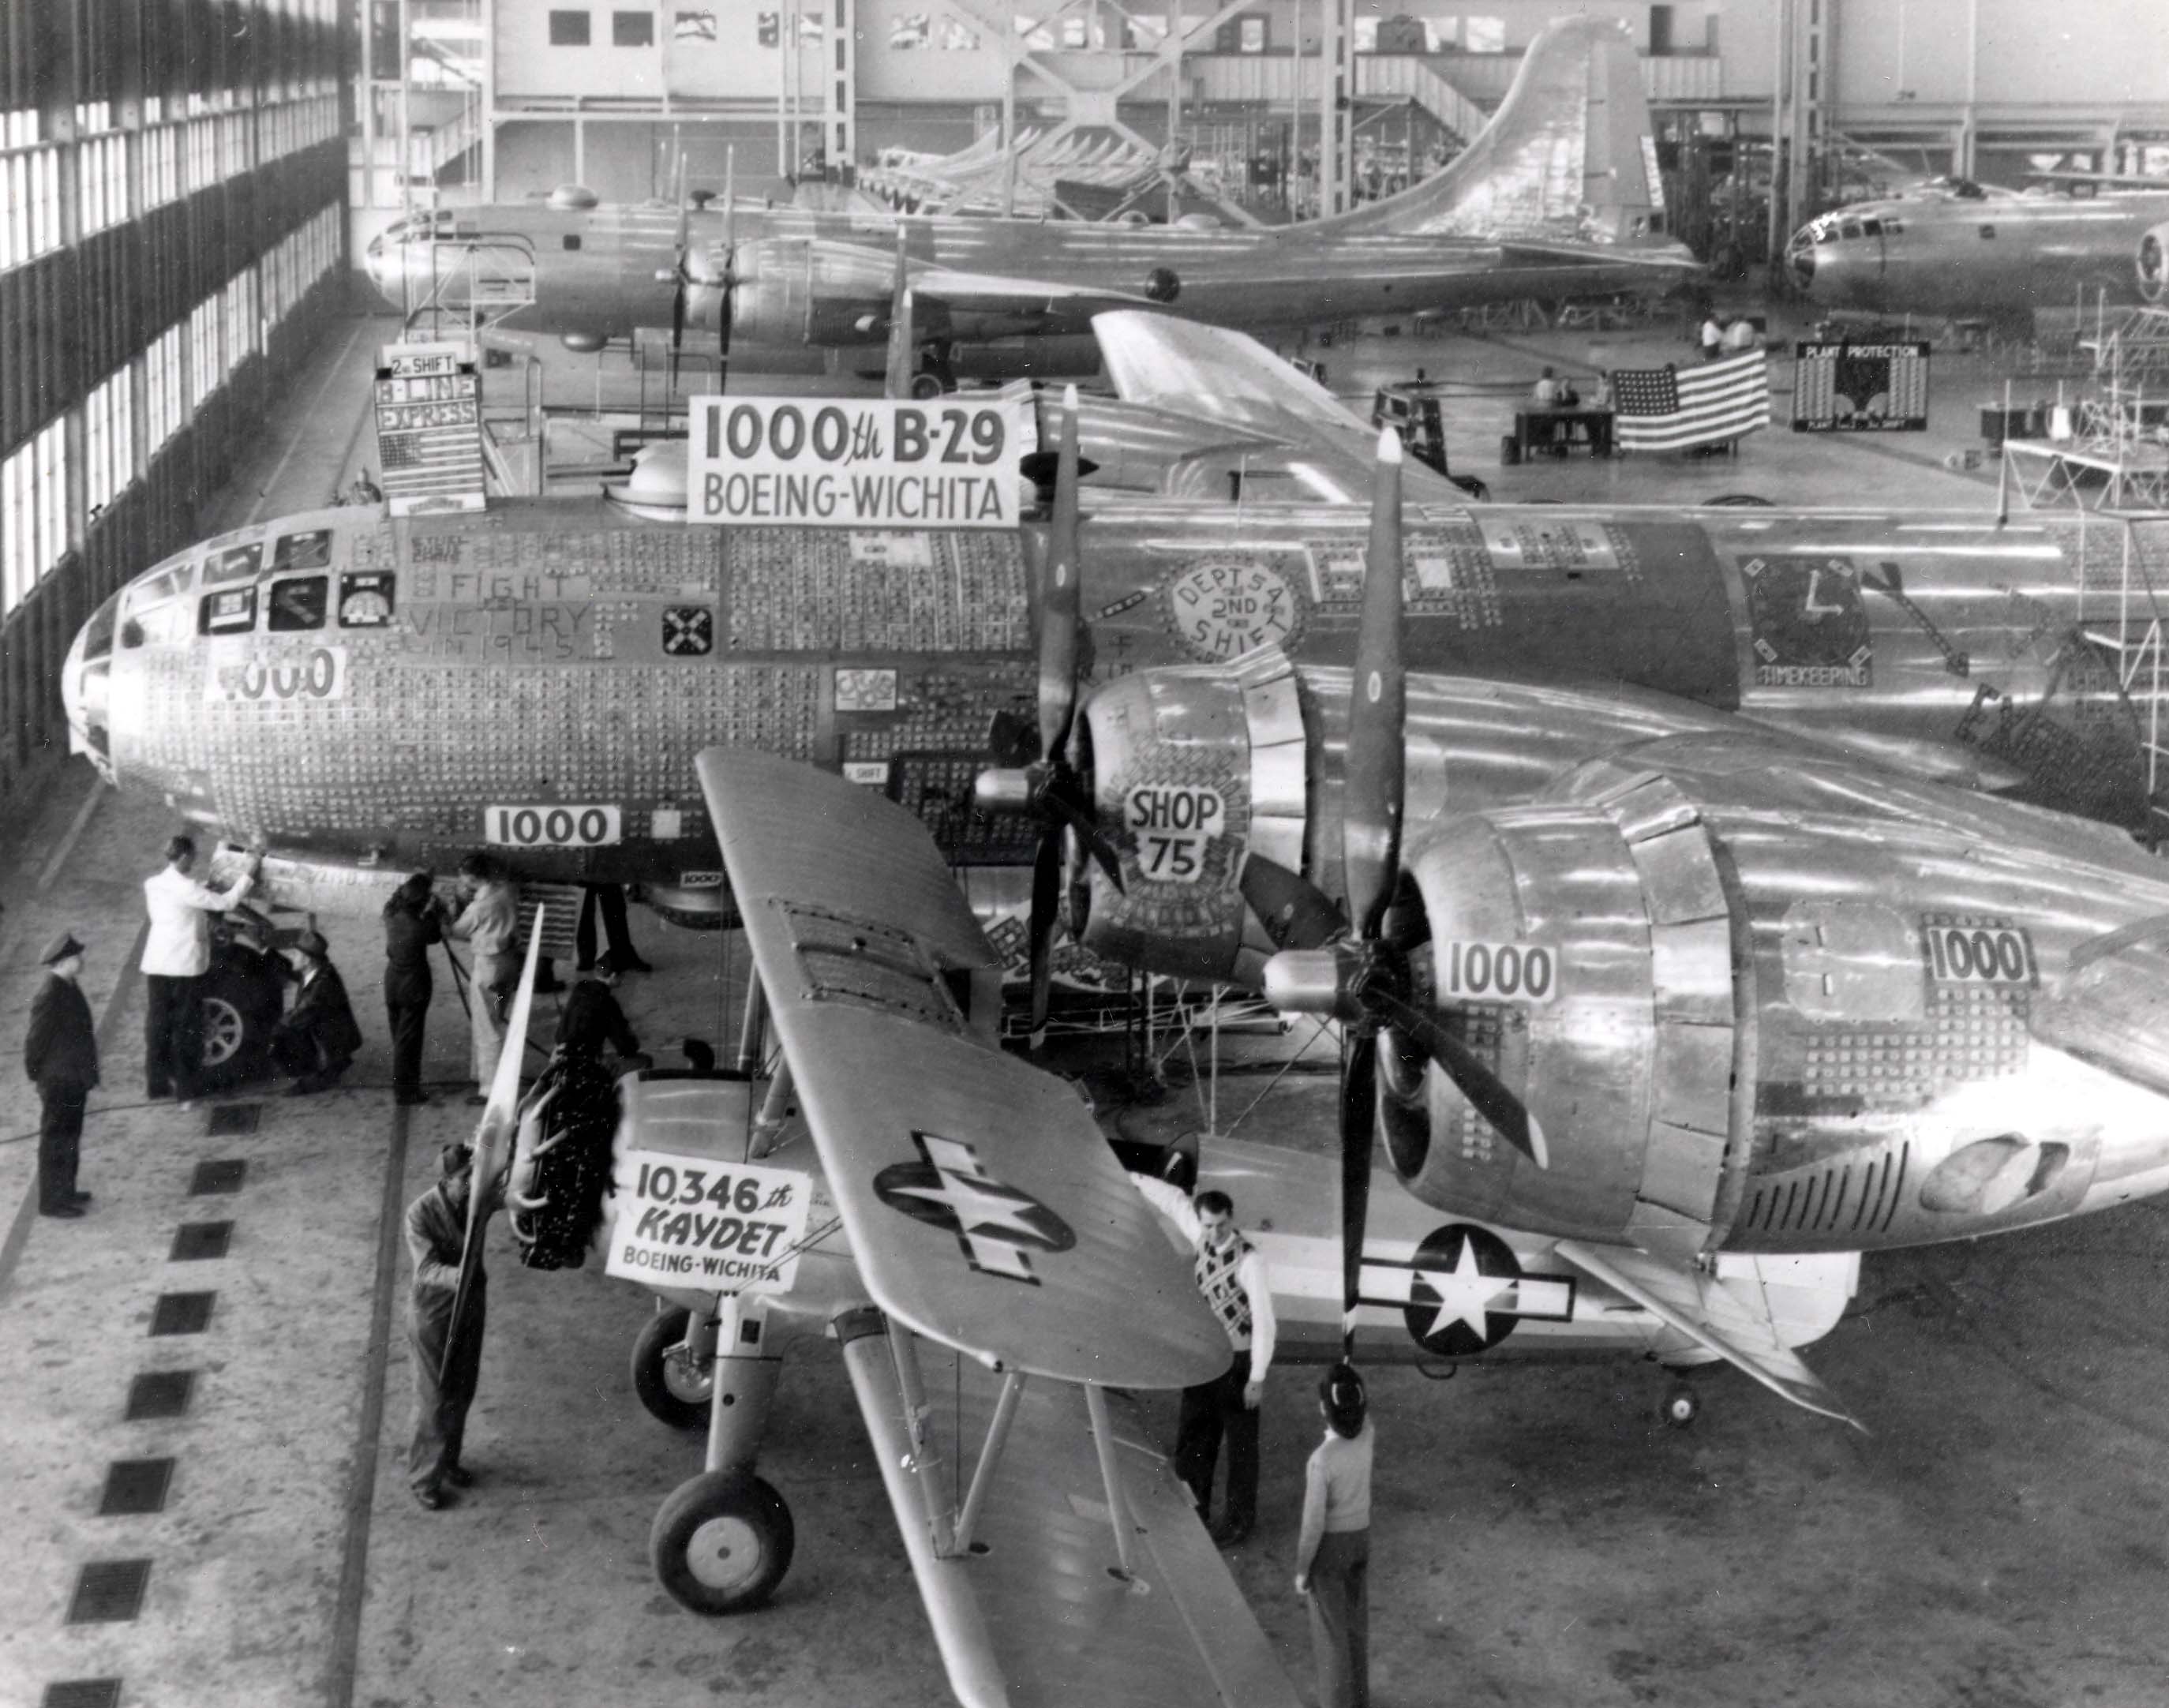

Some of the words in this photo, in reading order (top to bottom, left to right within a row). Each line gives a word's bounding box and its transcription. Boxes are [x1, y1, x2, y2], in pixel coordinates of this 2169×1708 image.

[413, 355, 453, 373] SHIFT
[706, 403, 884, 466] 1000th
[893, 408, 1005, 466] B-29
[703, 472, 1003, 520] BOEING-WICHITA
[1177, 568, 1242, 606] DEPT
[1212, 597, 1258, 619] 2ND
[1759, 665, 1867, 687] TIMEKEEPING
[499, 808, 608, 844] 1000
[1131, 789, 1219, 830] SHOP
[1148, 837, 1196, 875] 75
[1450, 942, 1552, 998] 1000
[1930, 930, 2025, 981] 1000
[636, 1163, 793, 1215] 10,346th
[635, 1206, 788, 1257] KAYDET
[622, 1245, 781, 1283] BOEING-WICHITA
